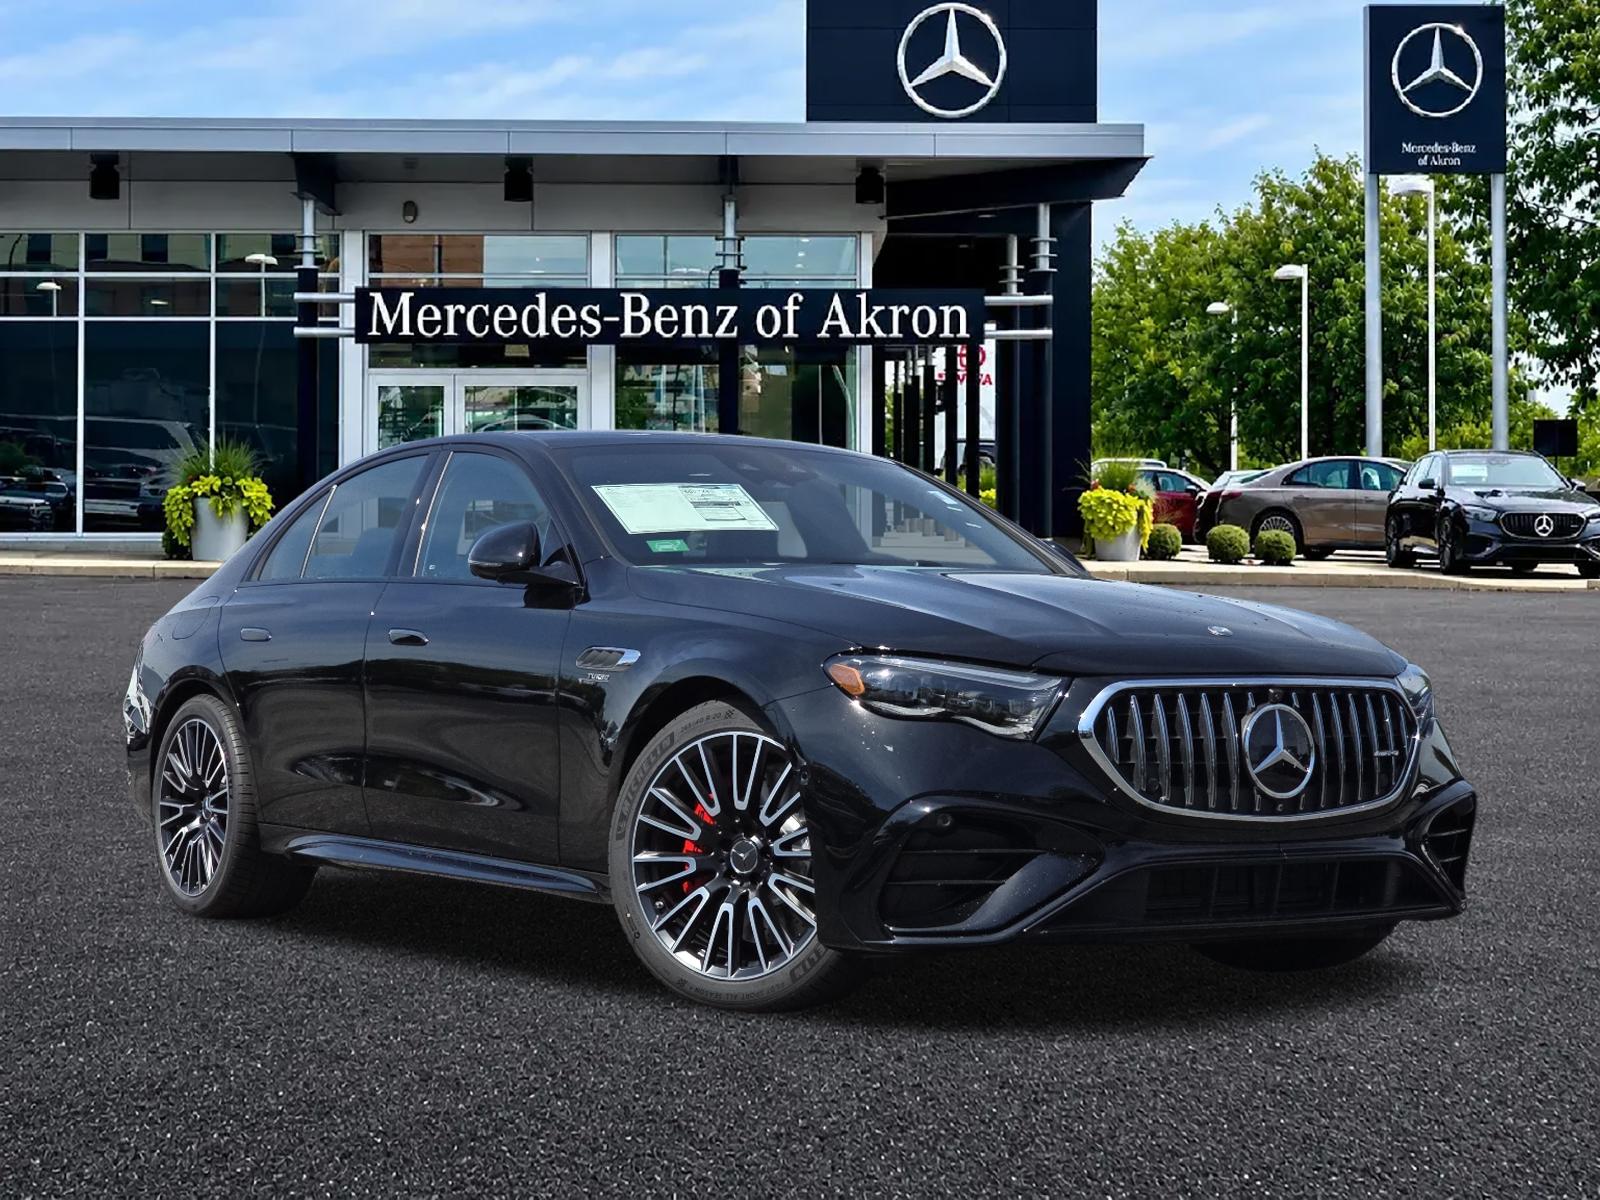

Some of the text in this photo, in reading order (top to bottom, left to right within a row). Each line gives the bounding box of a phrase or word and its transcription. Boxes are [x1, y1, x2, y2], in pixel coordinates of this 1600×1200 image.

[1401, 141, 1477, 153] Mercedes-Benz
[1417, 154, 1461, 165] of Akron
[367, 291, 970, 338] Mercedes-Benz of Akron
